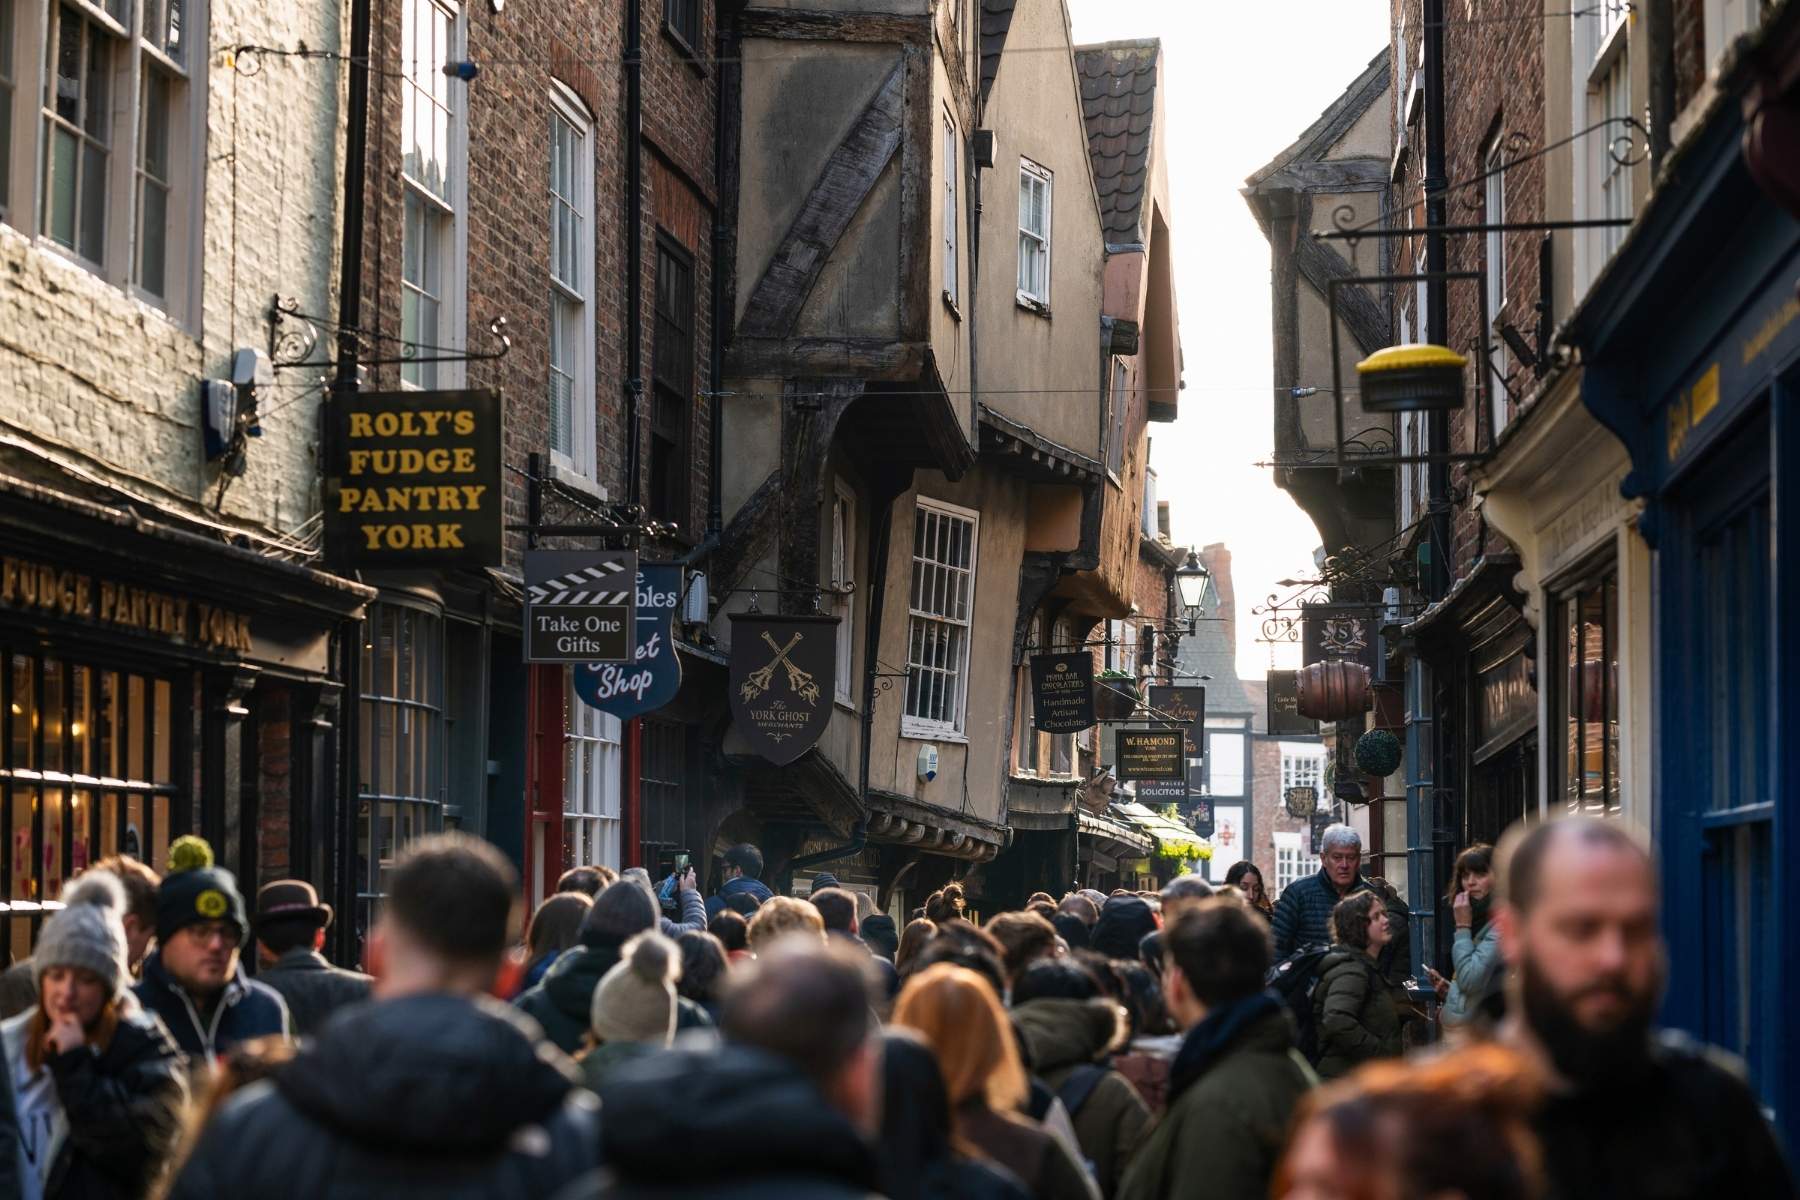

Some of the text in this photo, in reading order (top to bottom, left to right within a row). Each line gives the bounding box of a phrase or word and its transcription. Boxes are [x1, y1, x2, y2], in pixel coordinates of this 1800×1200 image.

[349, 410, 475, 437] ROLY'S
[349, 448, 476, 475] FUDGE
[338, 486, 486, 512] PANTRY
[361, 524, 465, 549] YORK
[3, 556, 92, 616] FUDGE
[536, 616, 622, 633] Take One
[556, 636, 601, 653] Gifts
[597, 665, 653, 701] Shop
[1043, 695, 1087, 707] Handmade
[750, 709, 810, 722] YORK GHOST
[1051, 708, 1079, 718] Artisan
[1043, 717, 1088, 729] Chocolates
[1141, 788, 1186, 797] SOLICITORS
